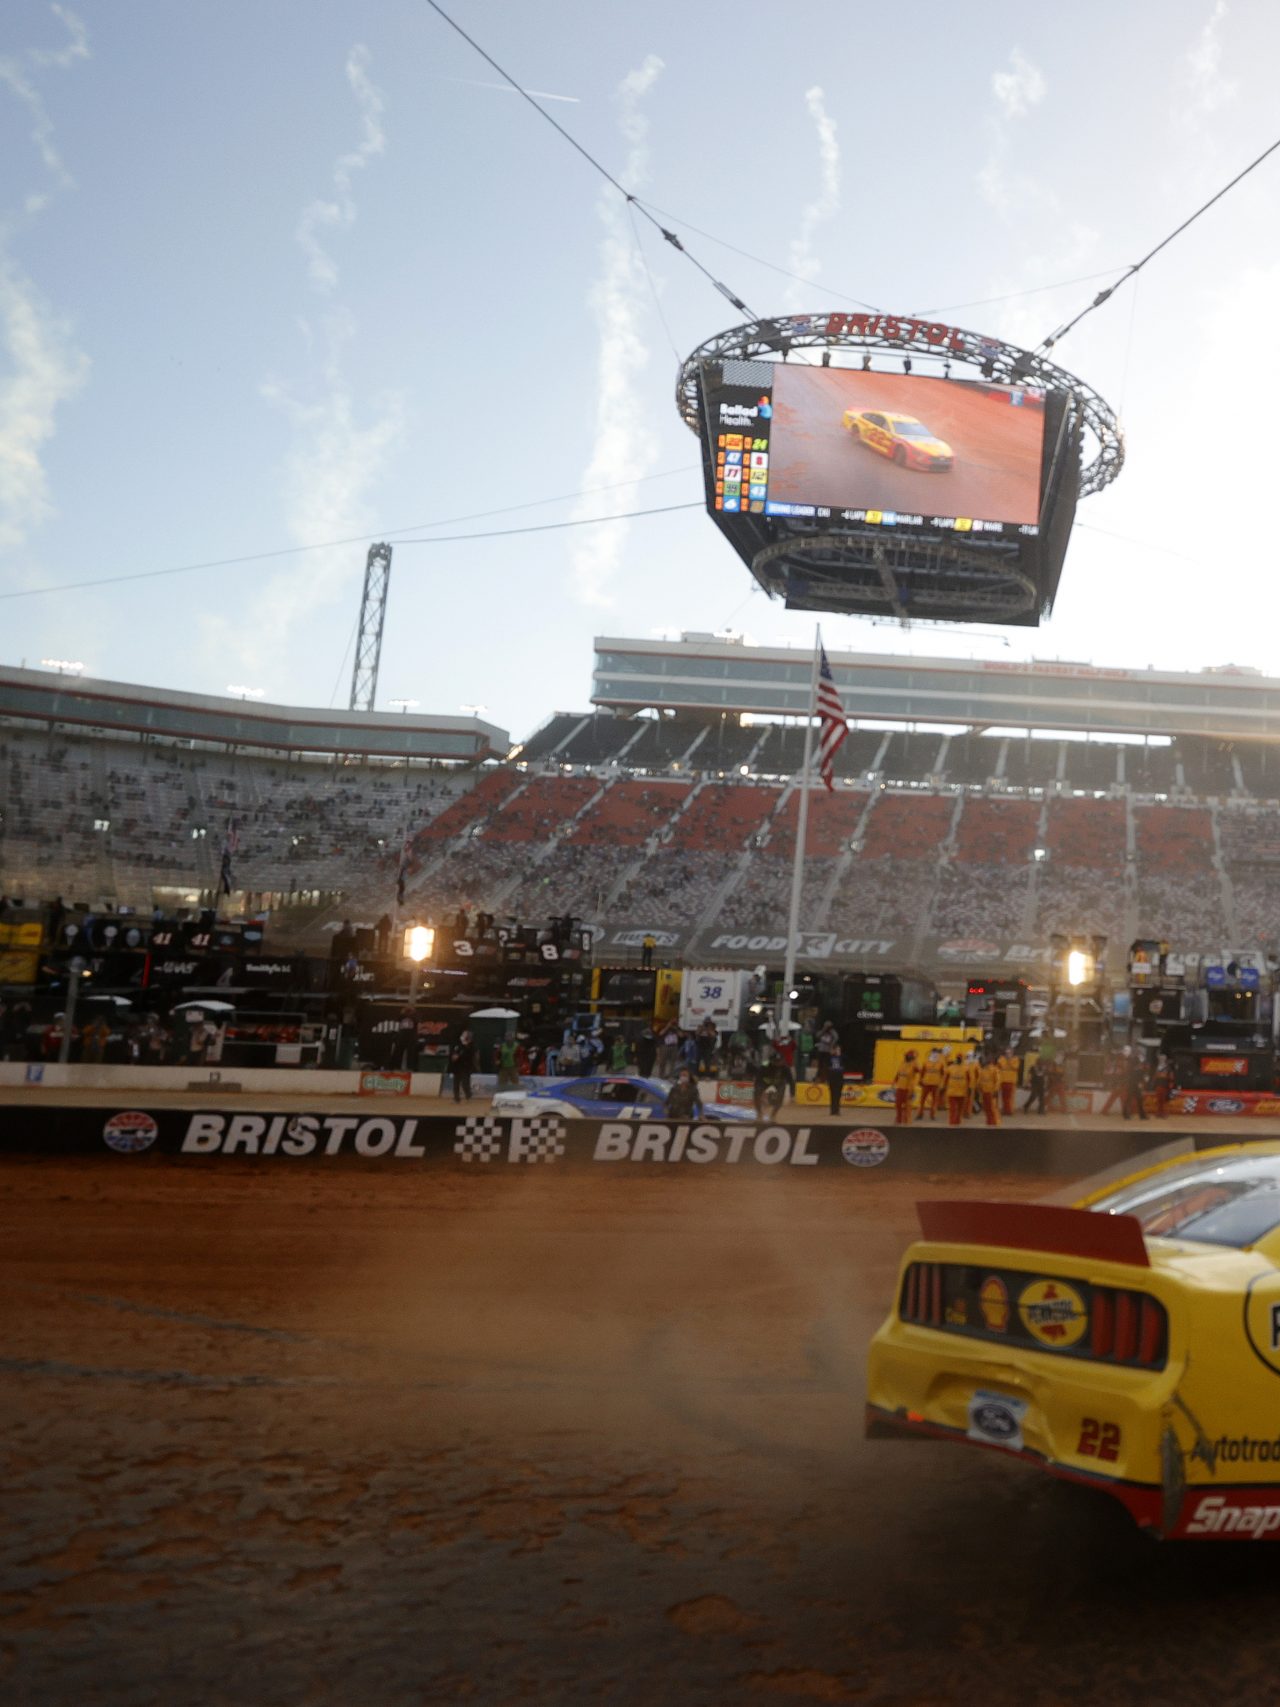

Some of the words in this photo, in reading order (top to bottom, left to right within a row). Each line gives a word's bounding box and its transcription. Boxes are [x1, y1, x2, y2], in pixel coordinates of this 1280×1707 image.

[825, 313, 964, 351] BRISTOL
[720, 403, 758, 417] Ballad
[153, 932, 173, 945] 41
[191, 933, 211, 946] 41
[711, 934, 786, 950] FOOD
[834, 940, 896, 955] CITY
[453, 940, 474, 956] 3
[541, 943, 559, 960] 8
[700, 986, 722, 1000] 38
[181, 1114, 426, 1158] BRISTOL
[593, 1123, 820, 1165] BRISTOL
[1078, 1417, 1122, 1463] 22
